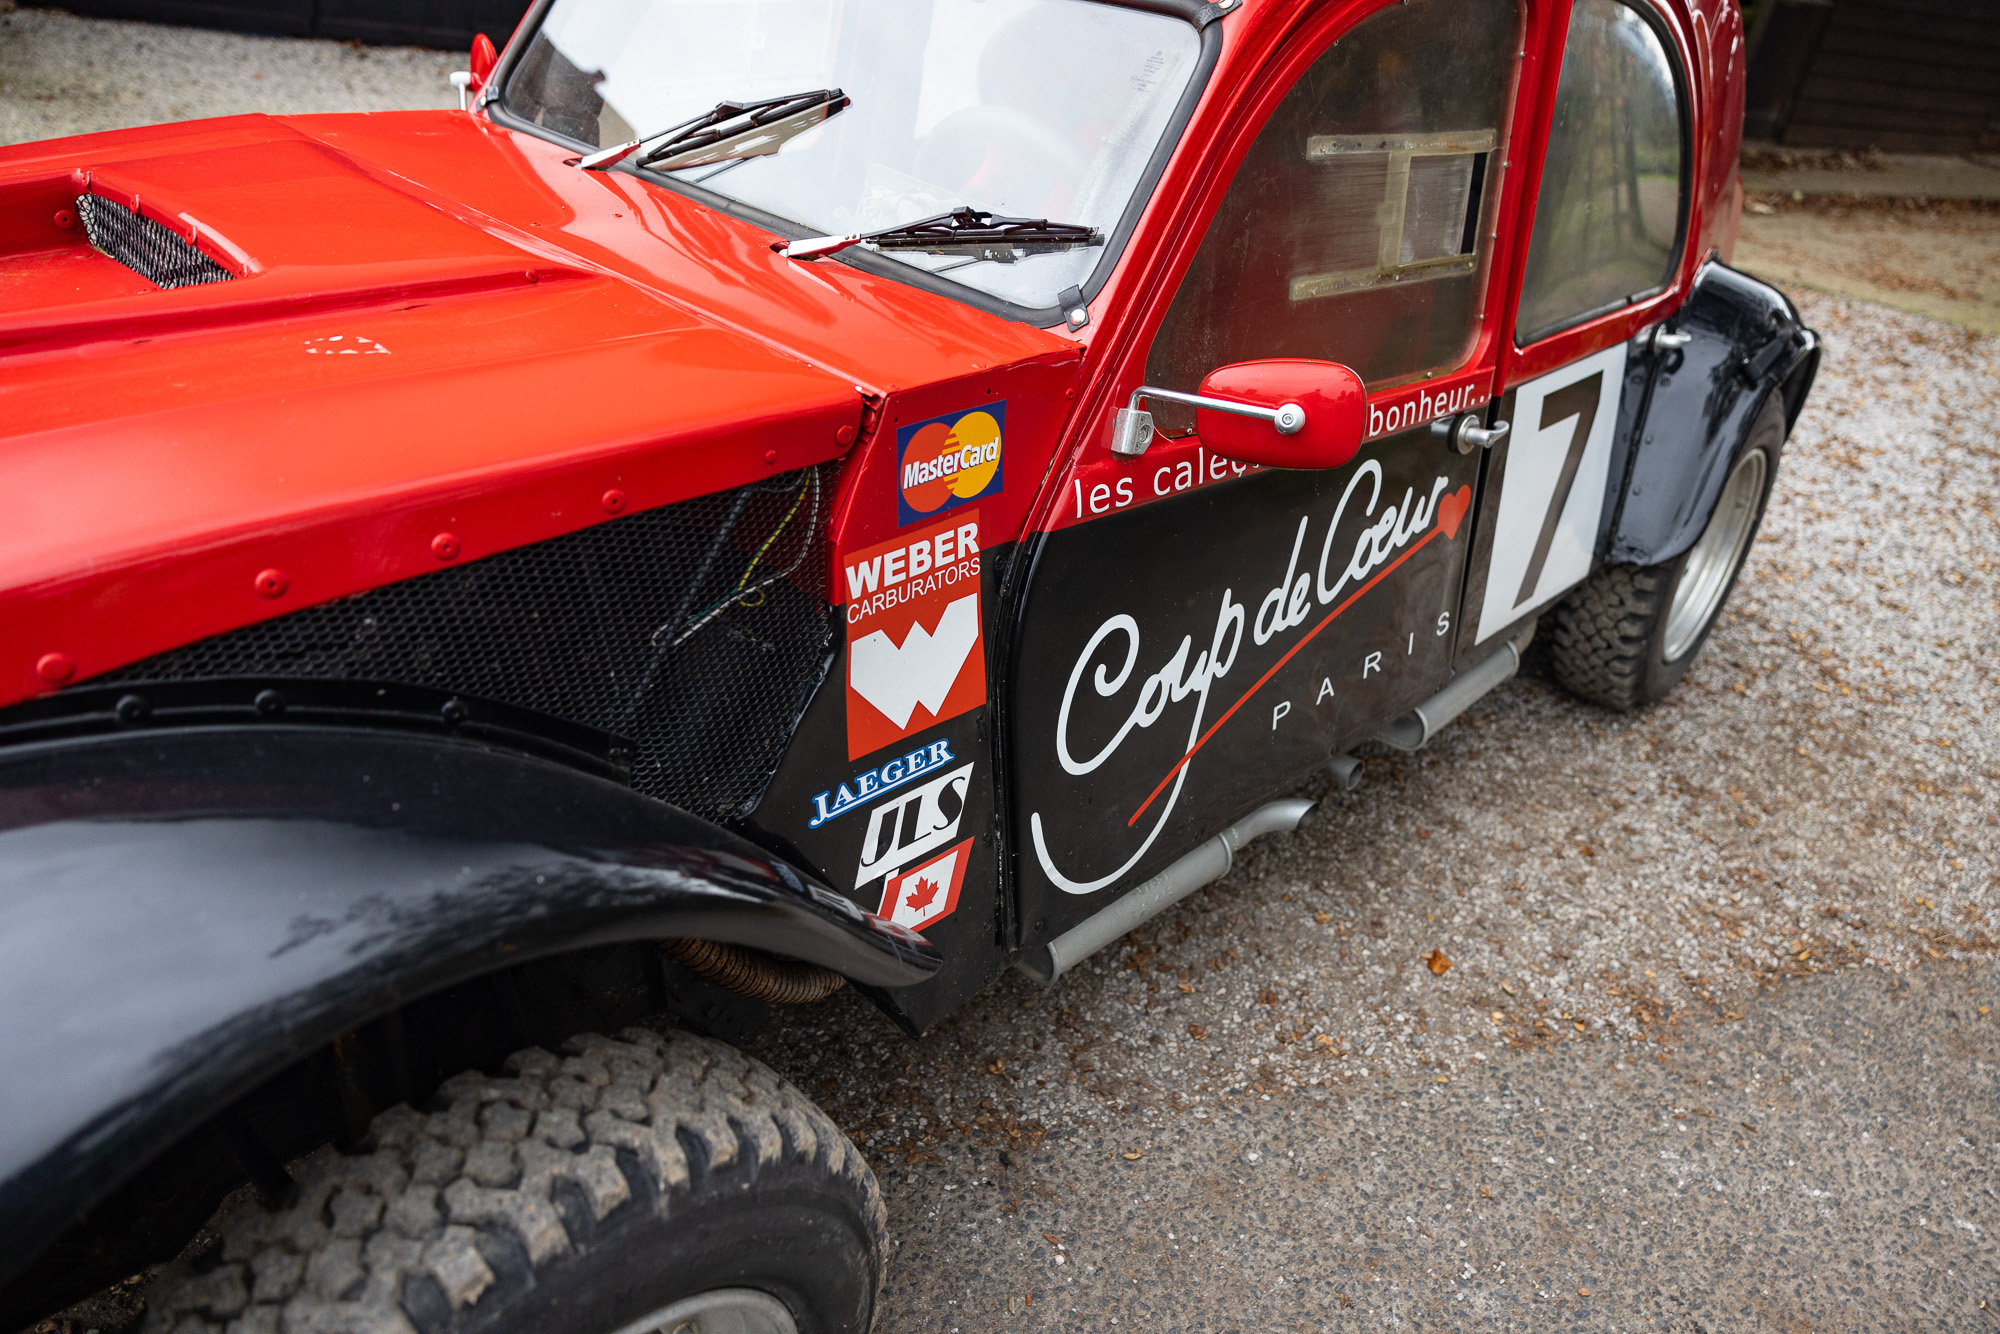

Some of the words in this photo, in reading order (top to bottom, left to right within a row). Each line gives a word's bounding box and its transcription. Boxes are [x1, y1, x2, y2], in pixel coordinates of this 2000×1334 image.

[903, 436, 999, 490] MasterCard
[1074, 478, 1133, 518] les
[1153, 446, 1260, 496] caleç
[1511, 369, 1604, 611] 7
[845, 522, 980, 600] WEBER
[846, 556, 981, 624] CARBURATORS
[1031, 588, 1249, 895] Coup
[1253, 516, 1311, 646] de
[1271, 611, 1451, 731] PARIS
[808, 738, 955, 828] JAEGER
